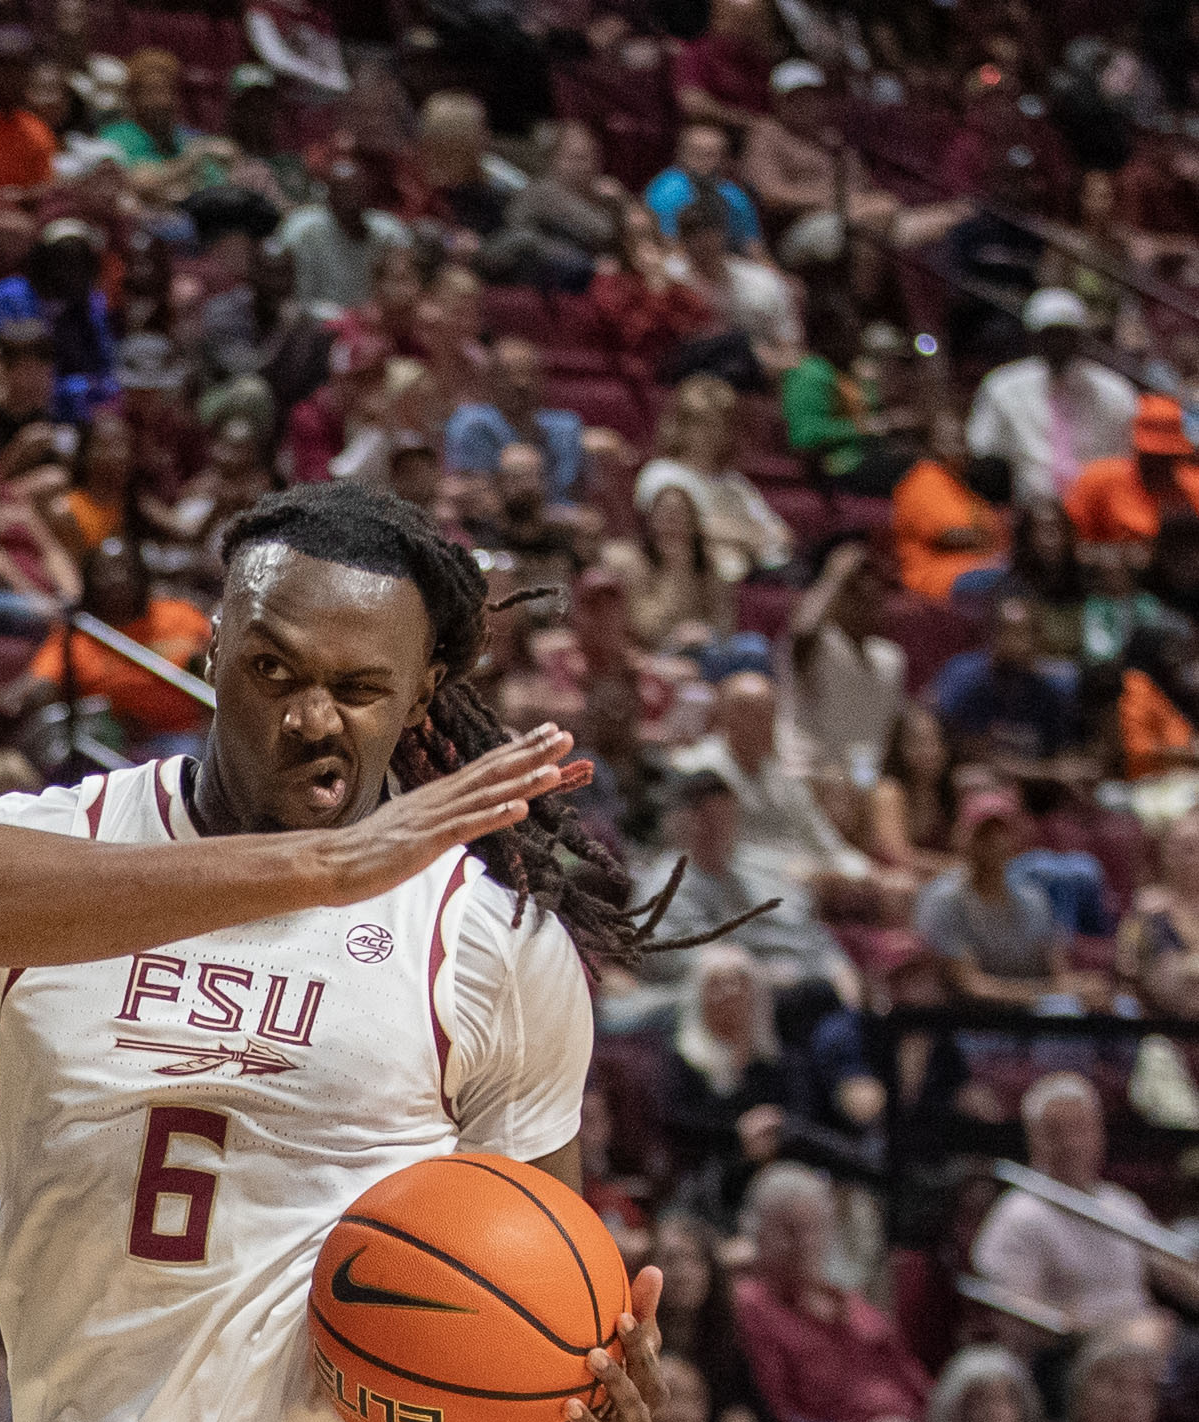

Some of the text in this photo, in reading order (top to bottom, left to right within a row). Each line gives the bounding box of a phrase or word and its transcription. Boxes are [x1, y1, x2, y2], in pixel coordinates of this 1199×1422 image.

[352, 935, 393, 950] ACC
[114, 952, 326, 1048] FSU
[125, 1101, 232, 1266] 6
